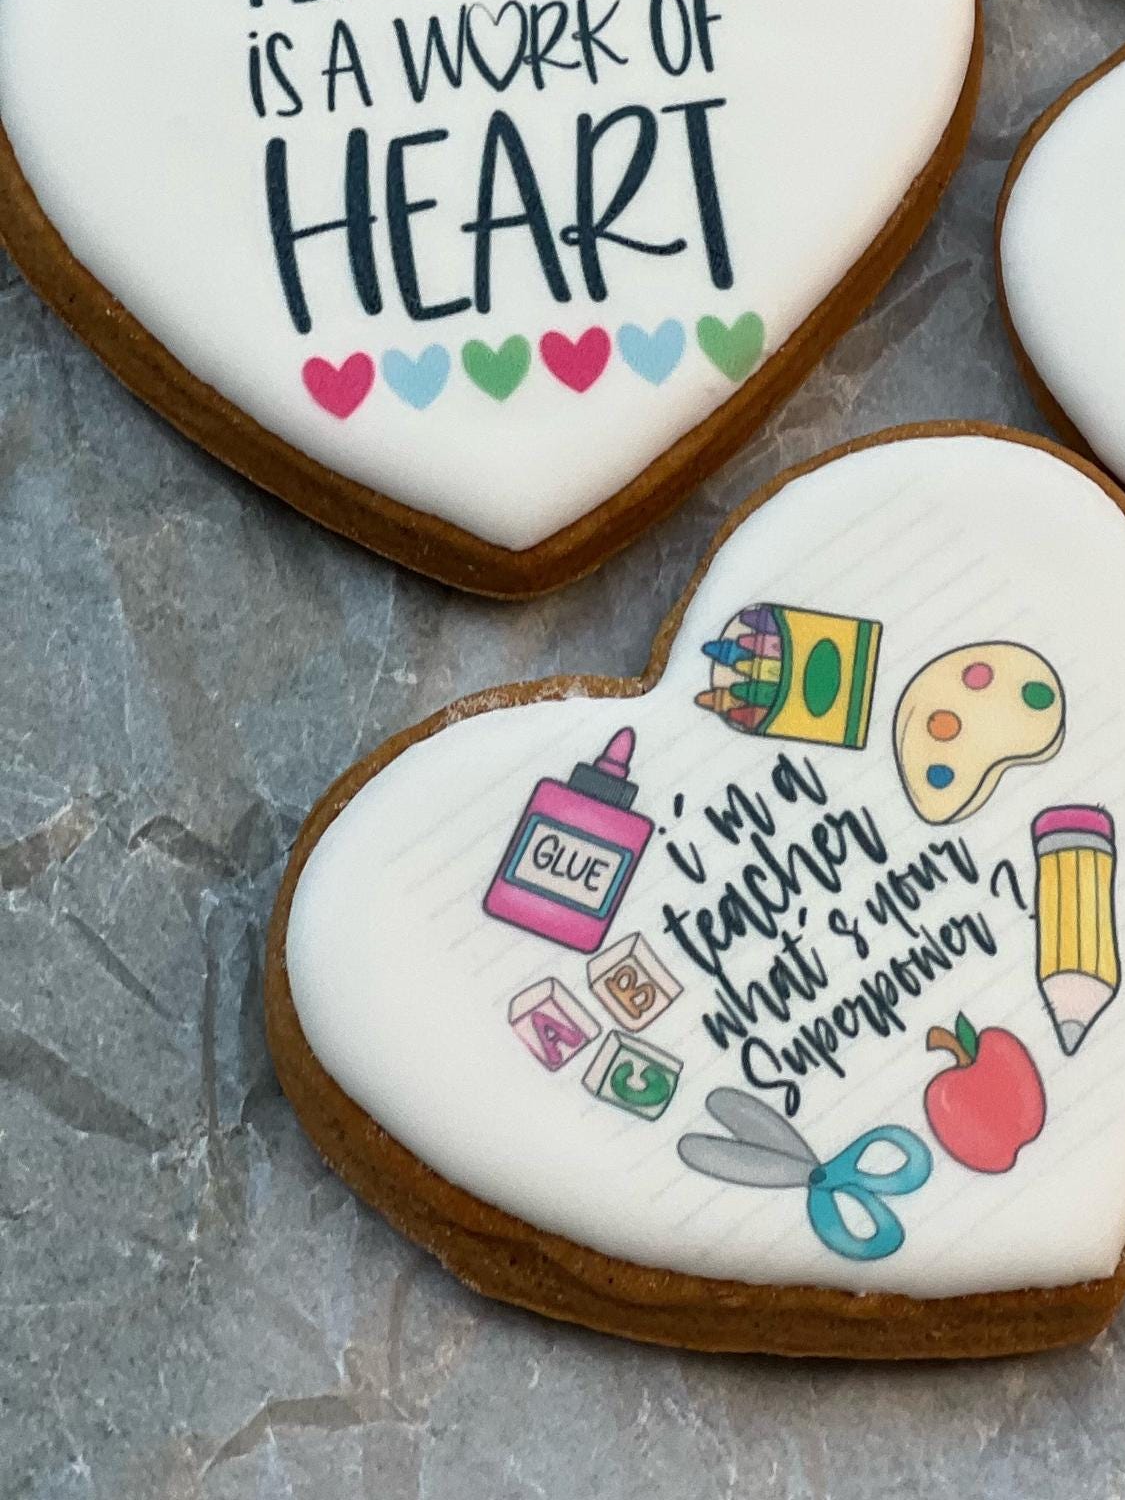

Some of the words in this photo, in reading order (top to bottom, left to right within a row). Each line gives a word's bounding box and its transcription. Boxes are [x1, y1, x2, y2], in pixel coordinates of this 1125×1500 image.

[322, 18, 374, 112] A
[265, 97, 735, 335] HEART
[772, 754, 828, 806] a
[530, 832, 610, 894] GLUE
[662, 806, 888, 977] teacher
[865, 835, 979, 936] your
